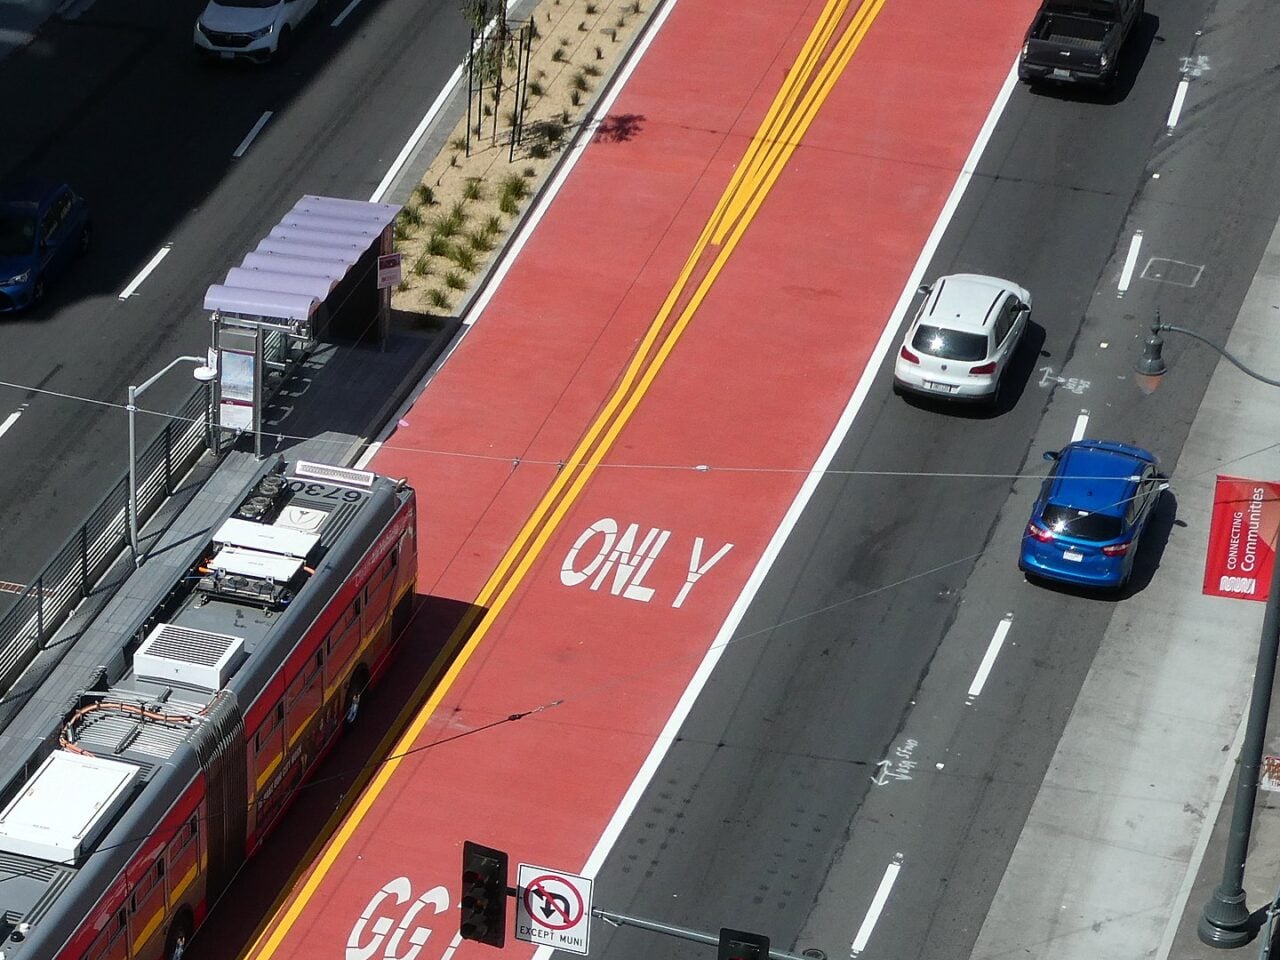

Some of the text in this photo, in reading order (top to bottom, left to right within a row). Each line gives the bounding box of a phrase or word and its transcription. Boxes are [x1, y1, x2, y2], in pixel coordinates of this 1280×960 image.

[289, 480, 363, 503] 6730
[1227, 511, 1243, 571] CONNECTING
[1240, 487, 1265, 572] Communities
[560, 517, 735, 609] ONLY
[519, 925, 583, 948] EXCEPT MUNI
